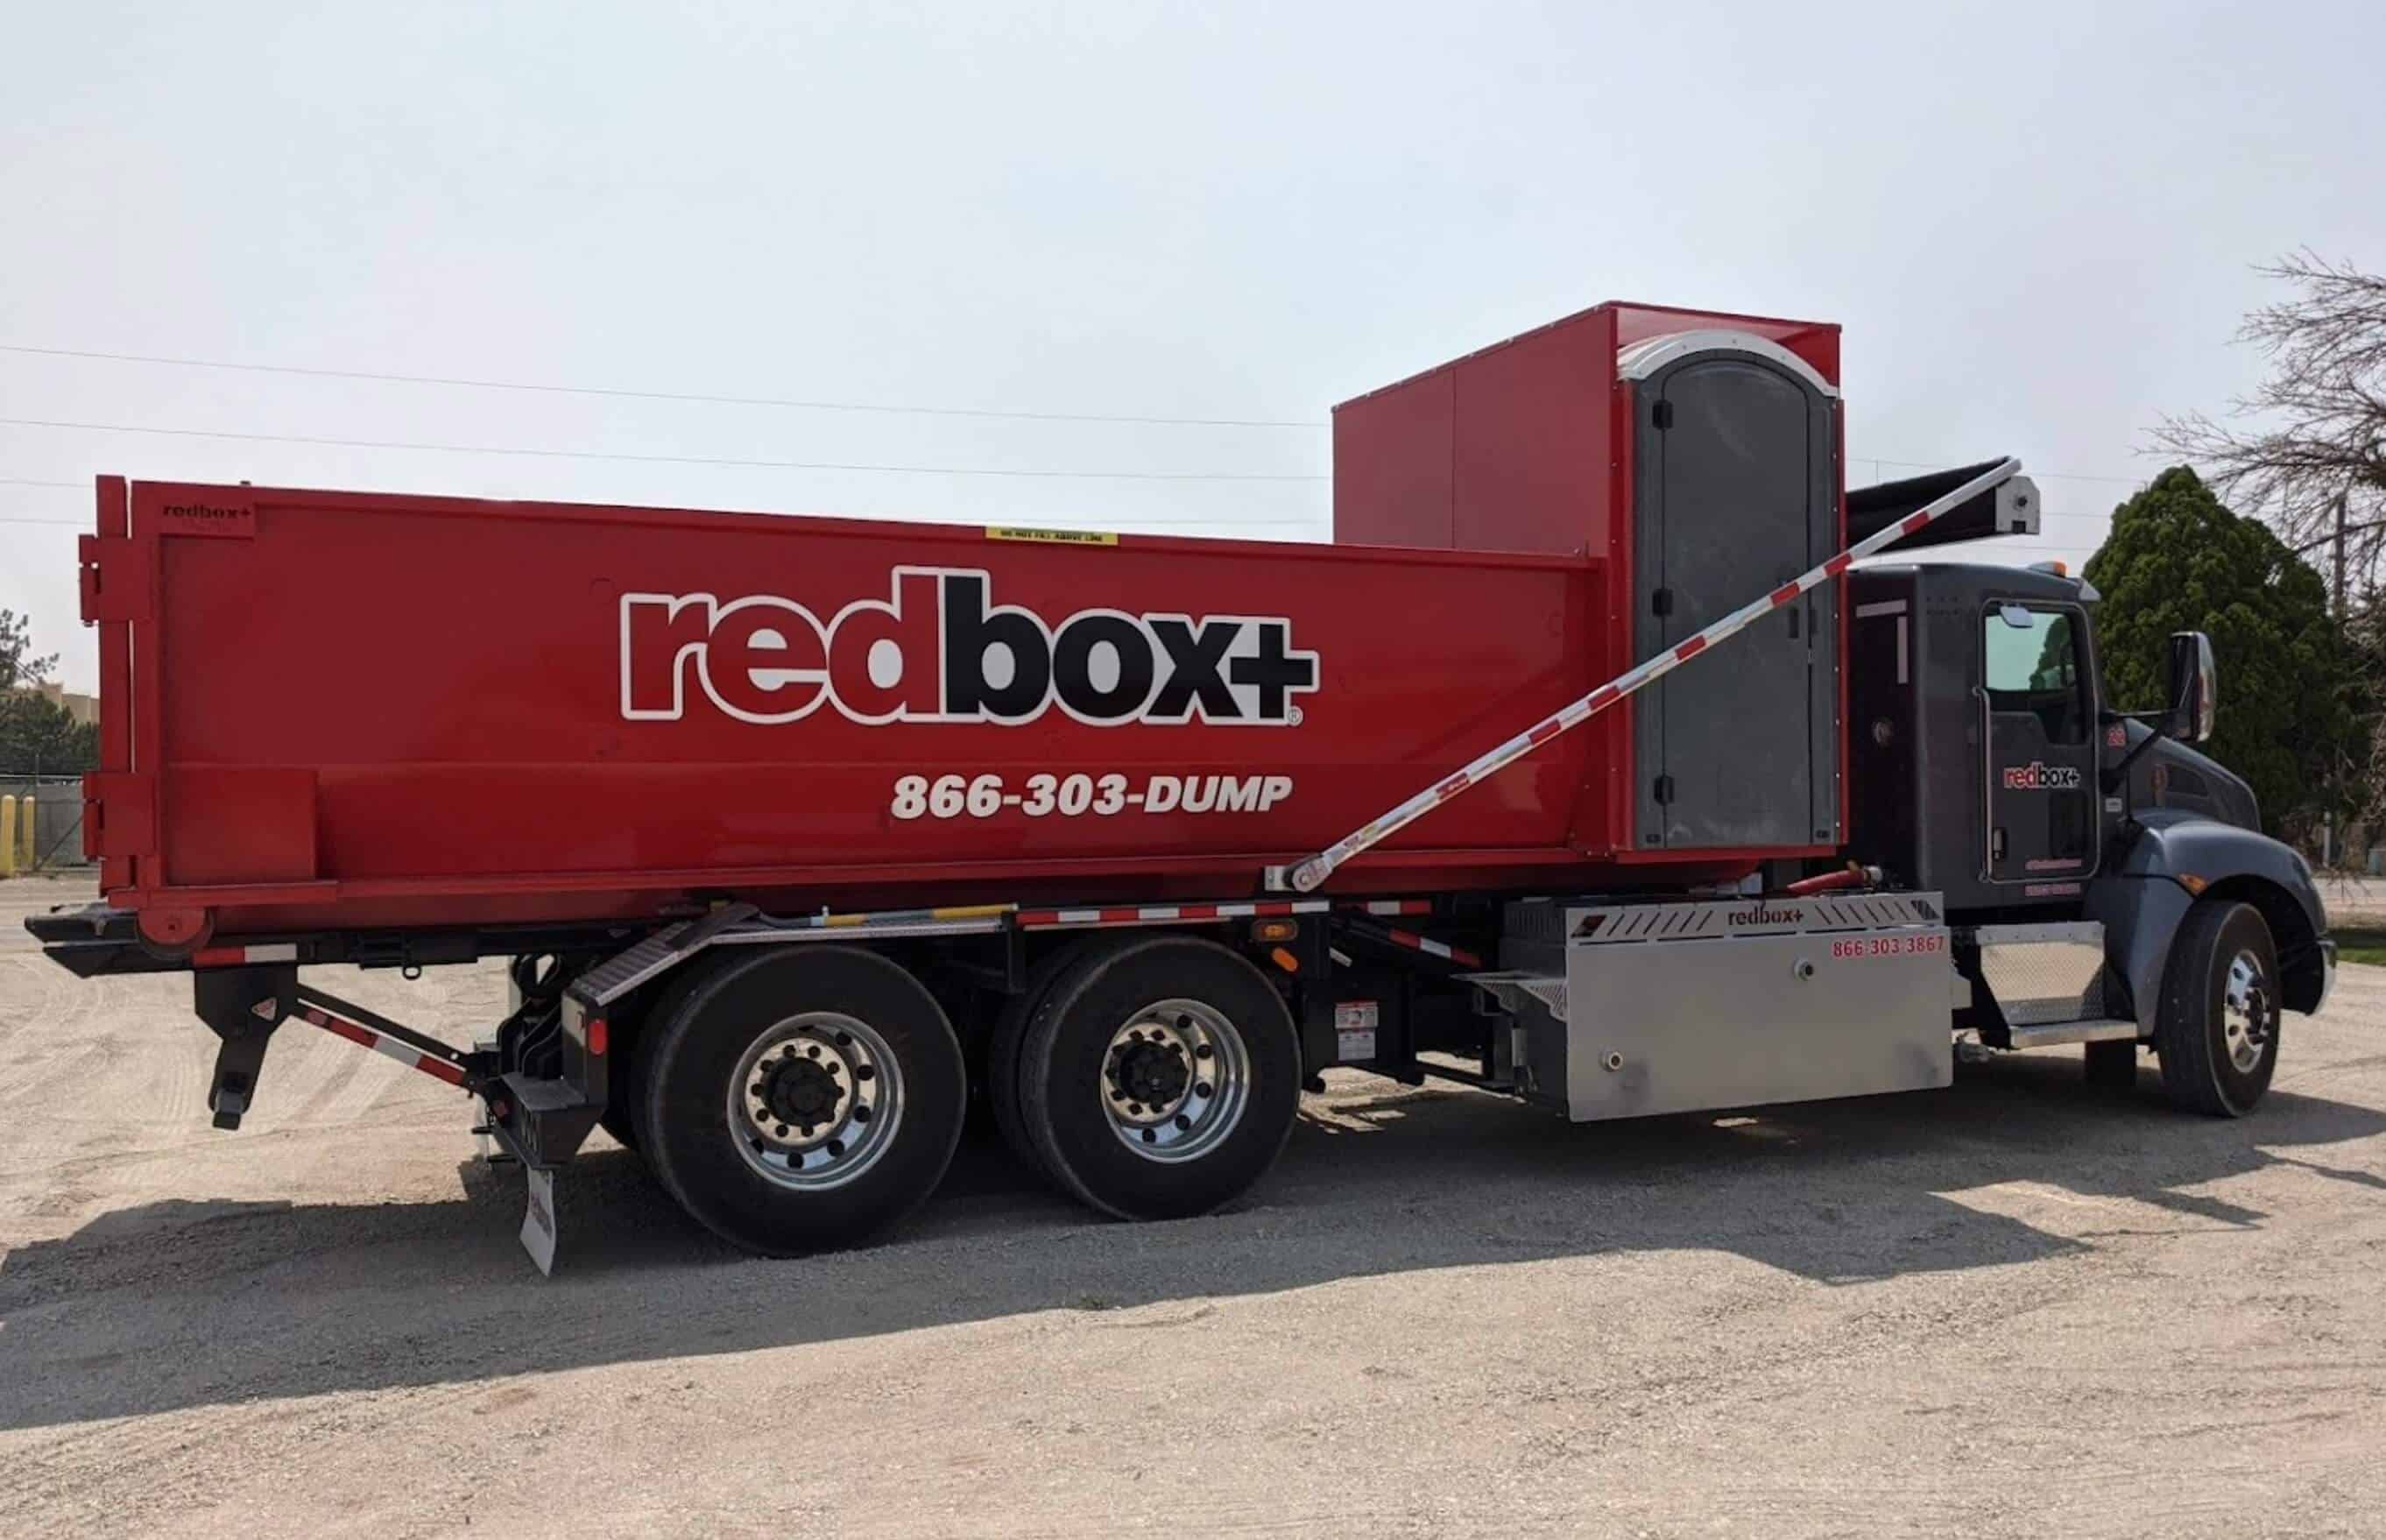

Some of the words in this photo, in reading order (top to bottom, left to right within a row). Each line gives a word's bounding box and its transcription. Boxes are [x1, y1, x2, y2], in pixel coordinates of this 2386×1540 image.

[162, 504, 251, 519] redbox+
[620, 565, 1320, 726] redbox+
[2004, 761, 2081, 788] redbox+
[890, 774, 1293, 819] 866-303-DUMP
[1728, 906, 1804, 926] redbox+
